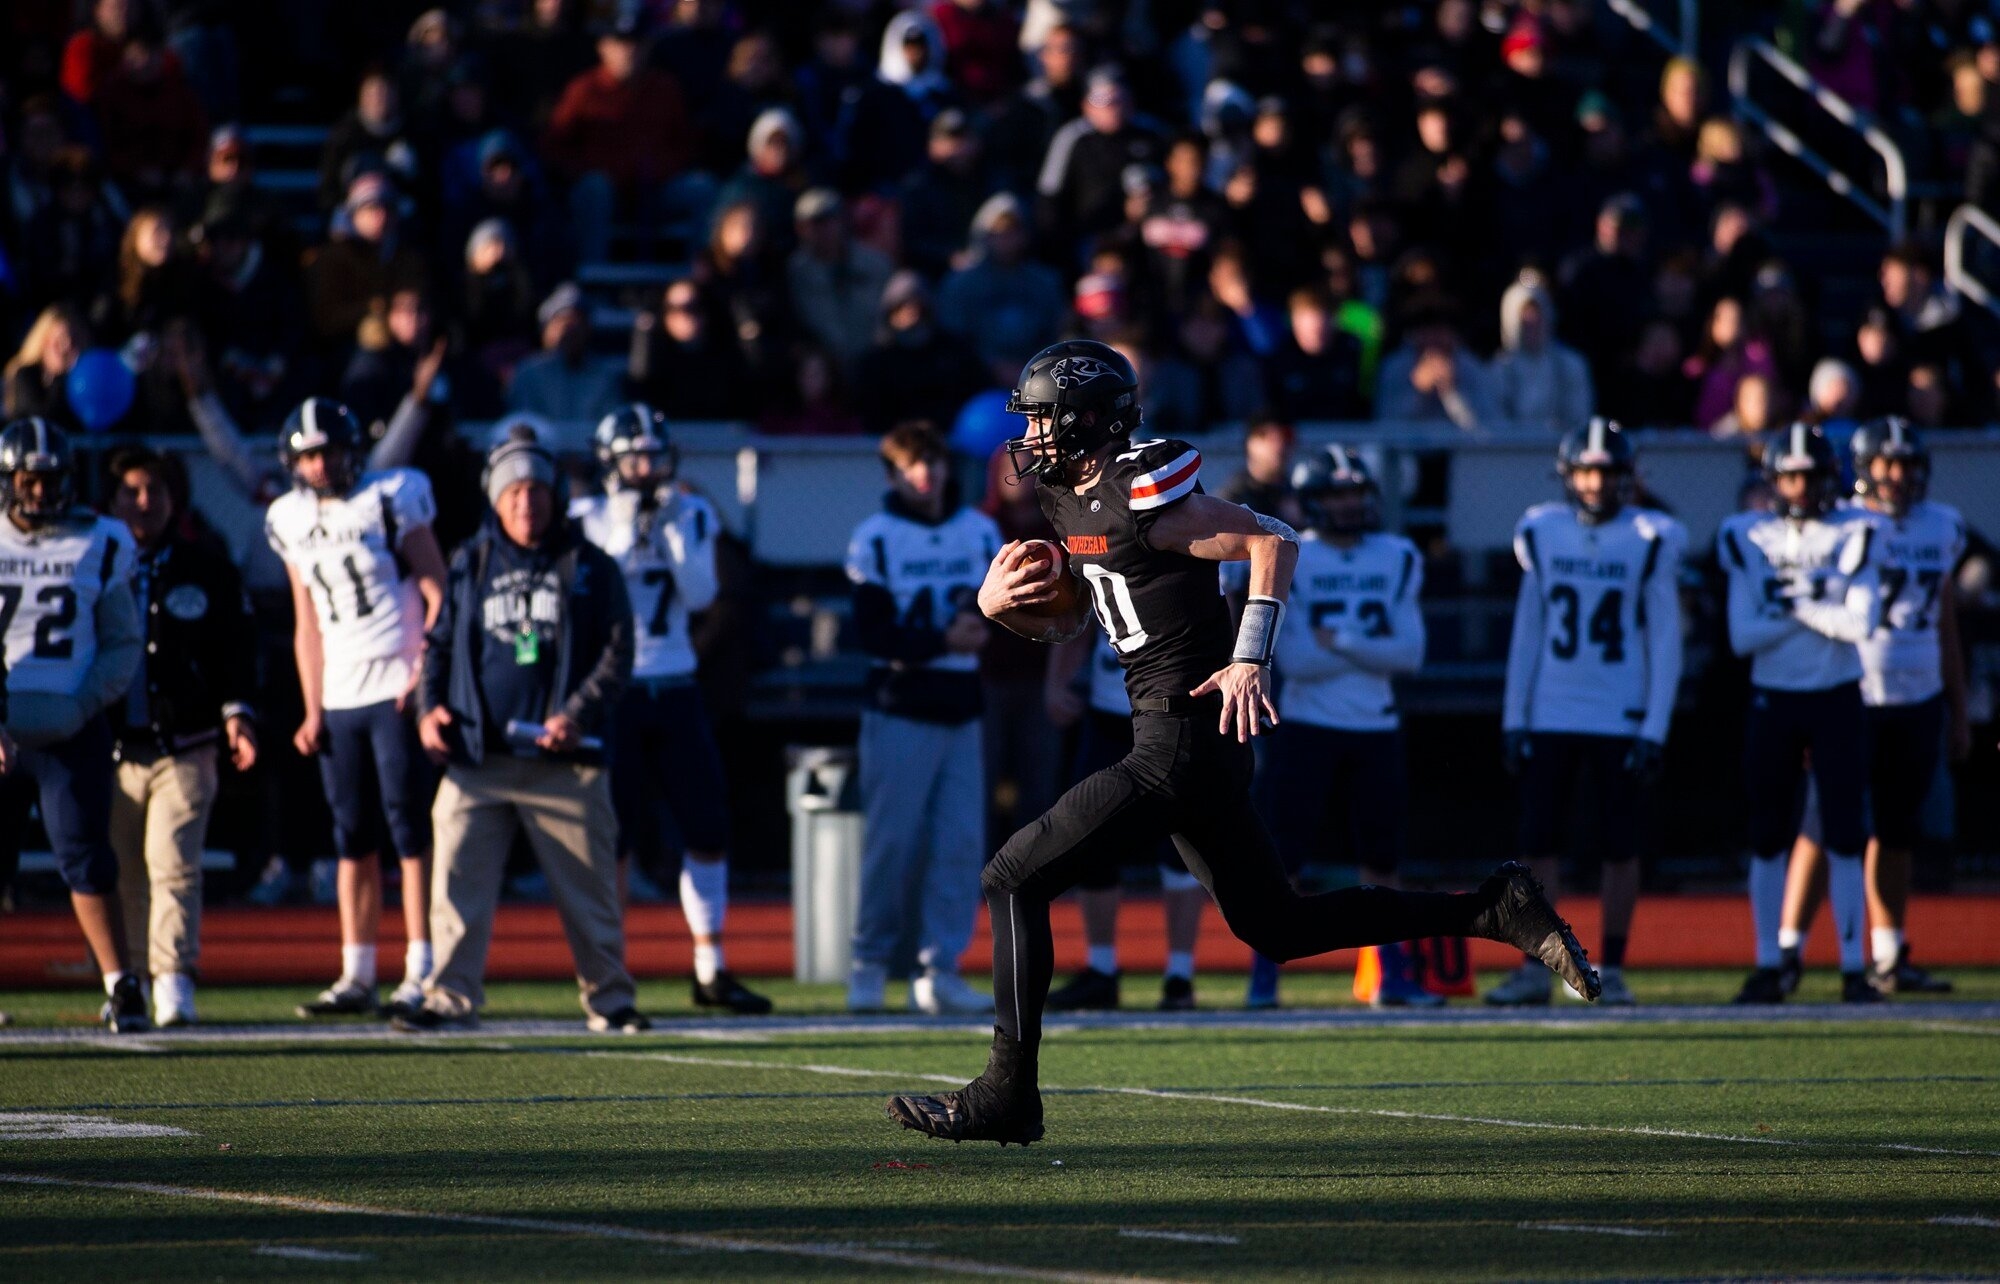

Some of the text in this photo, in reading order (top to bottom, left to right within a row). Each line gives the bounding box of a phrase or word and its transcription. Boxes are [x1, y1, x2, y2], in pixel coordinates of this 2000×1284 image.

[1066, 535, 1108, 555] OWHEGAN
[313, 554, 373, 622] 11
[643, 568, 676, 637] 7
[1082, 563, 1149, 653] 0
[1550, 583, 1624, 662] 34
